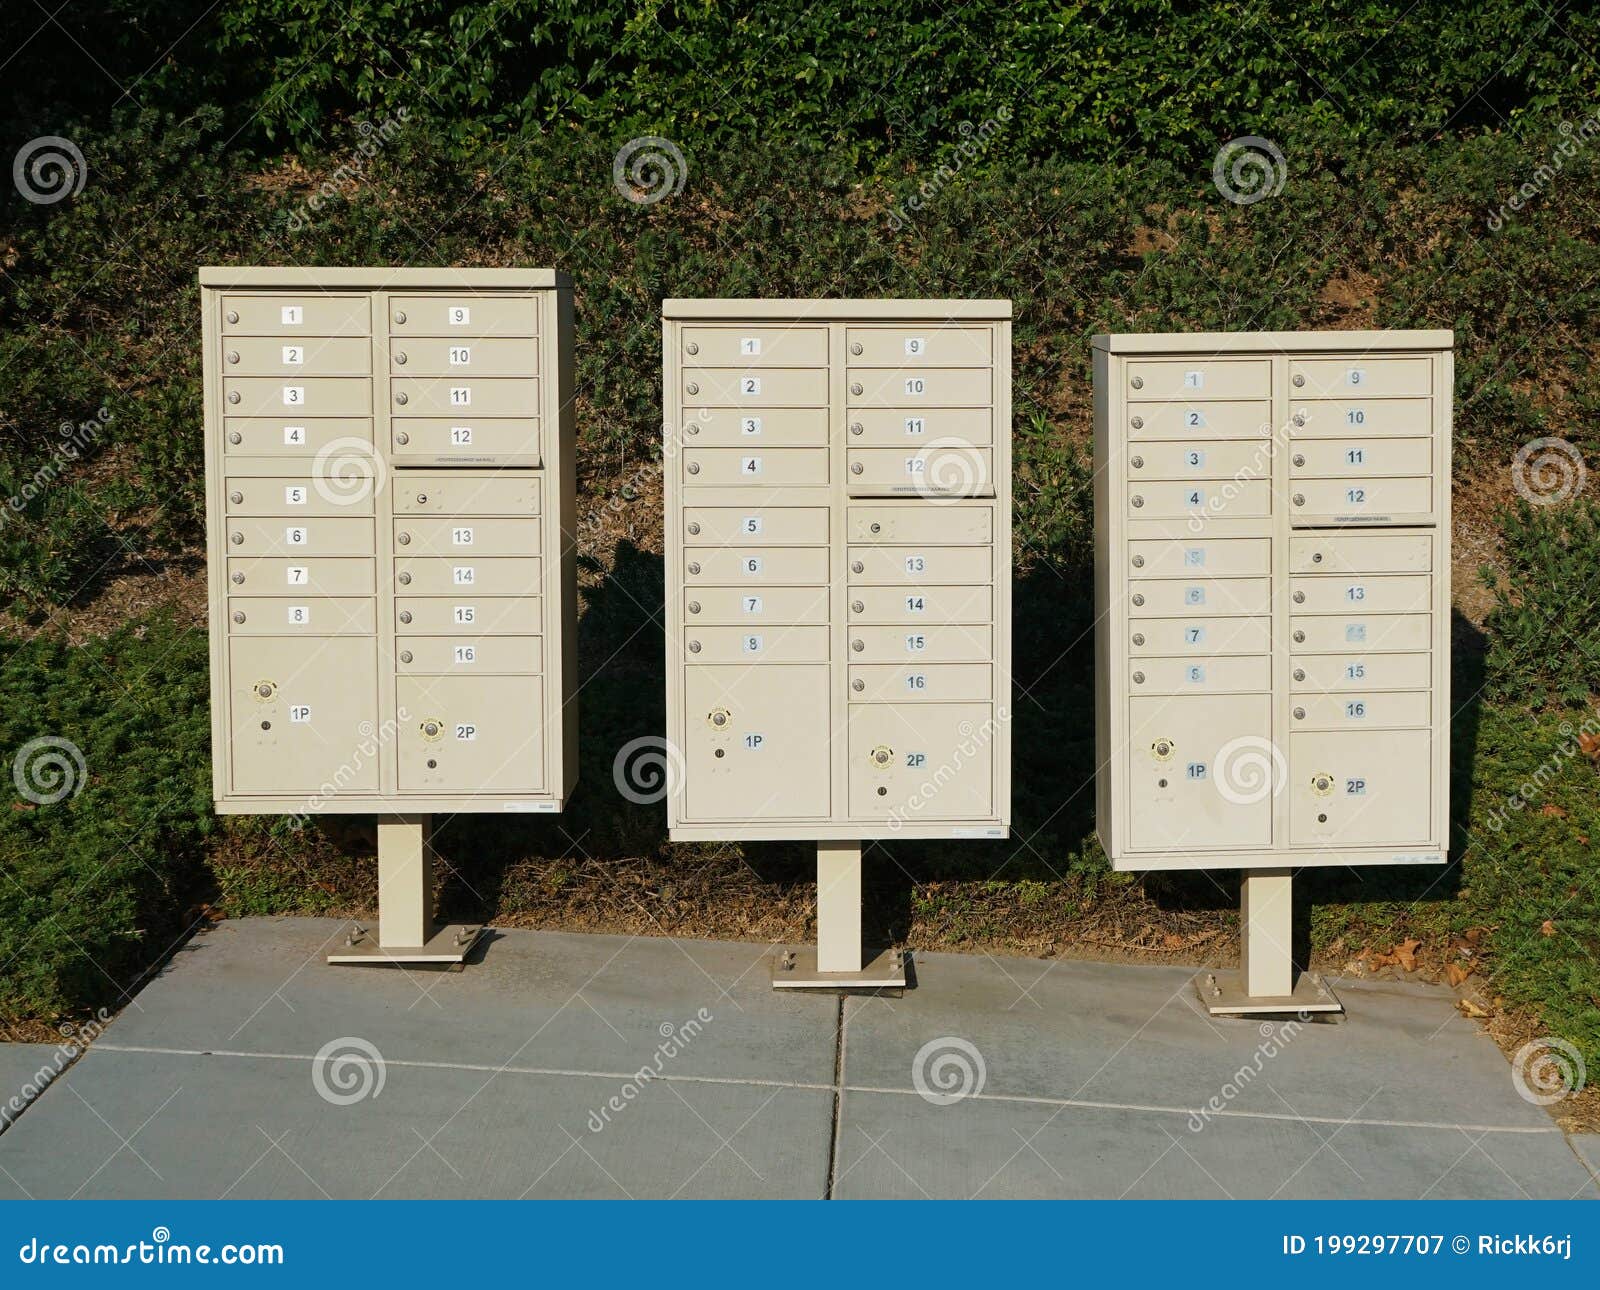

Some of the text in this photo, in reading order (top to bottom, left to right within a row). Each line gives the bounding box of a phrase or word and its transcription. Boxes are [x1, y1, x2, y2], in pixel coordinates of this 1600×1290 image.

[288, 309, 296, 322] 1
[455, 310, 464, 322] 9
[746, 340, 754, 353] 1
[910, 340, 919, 353] 9
[289, 349, 297, 362] 2
[452, 350, 468, 362] 10
[1189, 373, 1198, 386] 1
[1352, 371, 1360, 385] 9
[746, 380, 755, 393] 2
[906, 380, 923, 393] 10
[290, 389, 298, 402] 3
[453, 390, 467, 402] 11
[1190, 413, 1199, 426] 2
[1347, 411, 1364, 424] 10
[747, 420, 756, 433] 3
[907, 420, 921, 433] 11
[290, 430, 299, 442] 4
[453, 430, 470, 443] 12
[1190, 453, 1199, 465] 3
[1348, 450, 1362, 463] 11
[747, 459, 756, 472] 4
[906, 459, 924, 472] 12
[292, 489, 299, 502] 5
[1190, 492, 1200, 505] 4
[1348, 490, 1364, 503] 12
[748, 519, 757, 532] 5
[293, 530, 301, 542] 6
[454, 530, 472, 543] 13
[748, 559, 757, 572] 6
[907, 558, 924, 571] 13
[293, 569, 302, 582] 7
[455, 569, 473, 582] 14
[1348, 587, 1364, 600] 13
[749, 599, 757, 611] 7
[907, 598, 924, 610] 14
[293, 609, 303, 622] 8
[456, 609, 473, 622] 15
[1191, 629, 1199, 642] 7
[749, 637, 758, 651] 8
[907, 636, 924, 649] 15
[456, 648, 474, 661] 16
[1347, 665, 1364, 678] 15
[907, 676, 924, 689] 16
[292, 707, 310, 720] 1P
[1347, 703, 1364, 716] 16
[457, 726, 475, 739] 2P
[746, 735, 762, 747] 1P
[907, 754, 925, 767] 2P
[1188, 765, 1205, 777] 1P
[1347, 780, 1365, 793] 2P
